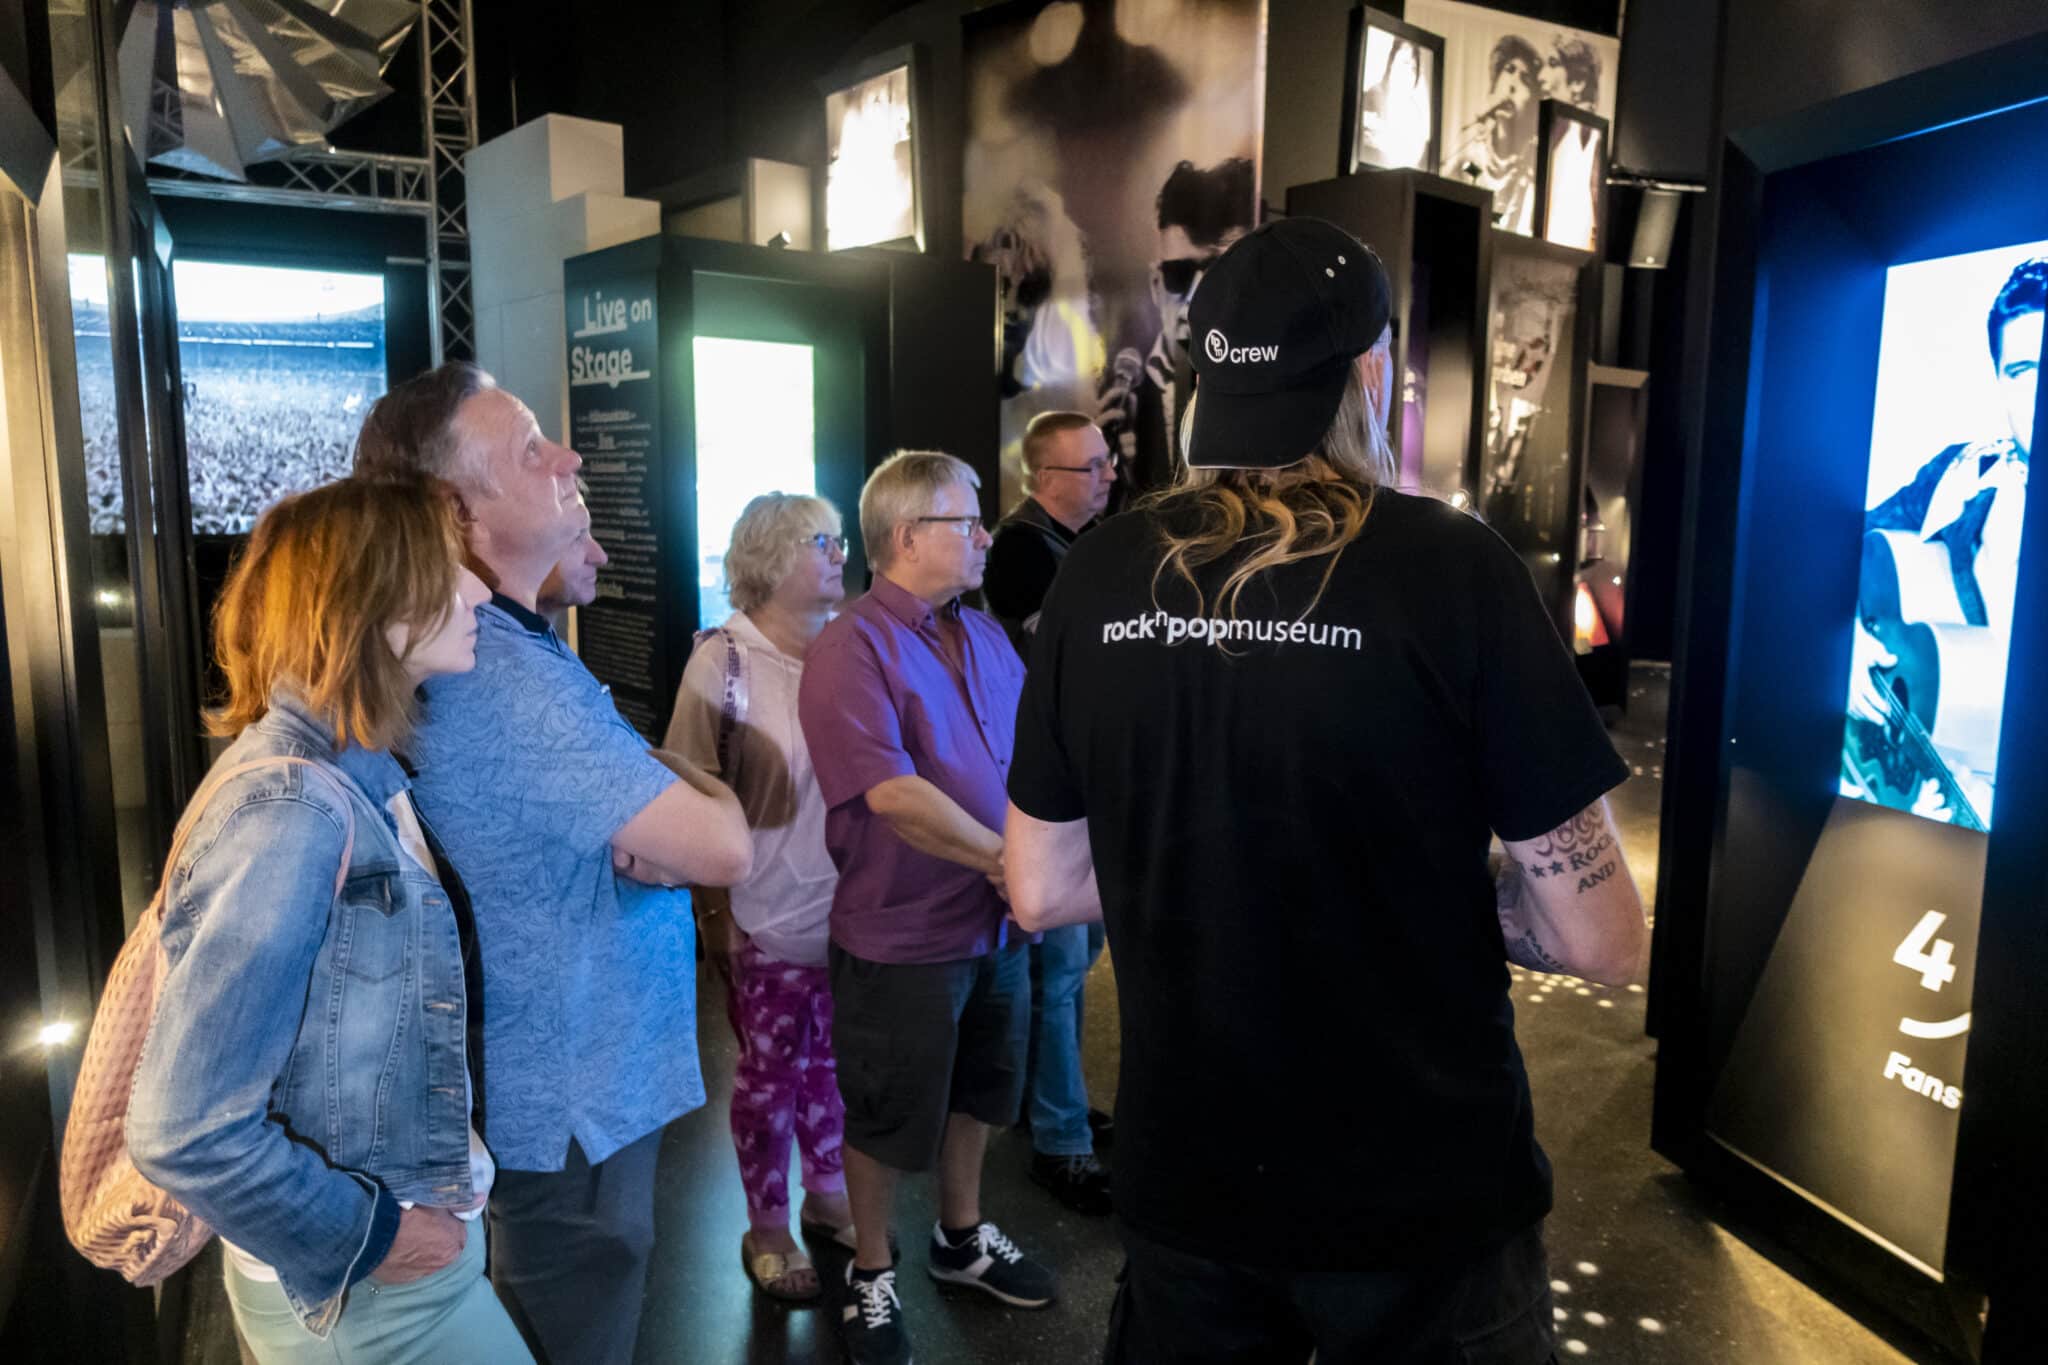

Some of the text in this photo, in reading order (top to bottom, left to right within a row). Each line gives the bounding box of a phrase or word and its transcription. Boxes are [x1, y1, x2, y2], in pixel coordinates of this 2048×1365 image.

[582, 291, 652, 334] Live on
[571, 346, 634, 389] Stage
[1230, 345, 1279, 364] crew
[1576, 861, 1617, 894] AND
[1893, 910, 1956, 992] 4
[1883, 1051, 1963, 1110] Fans
